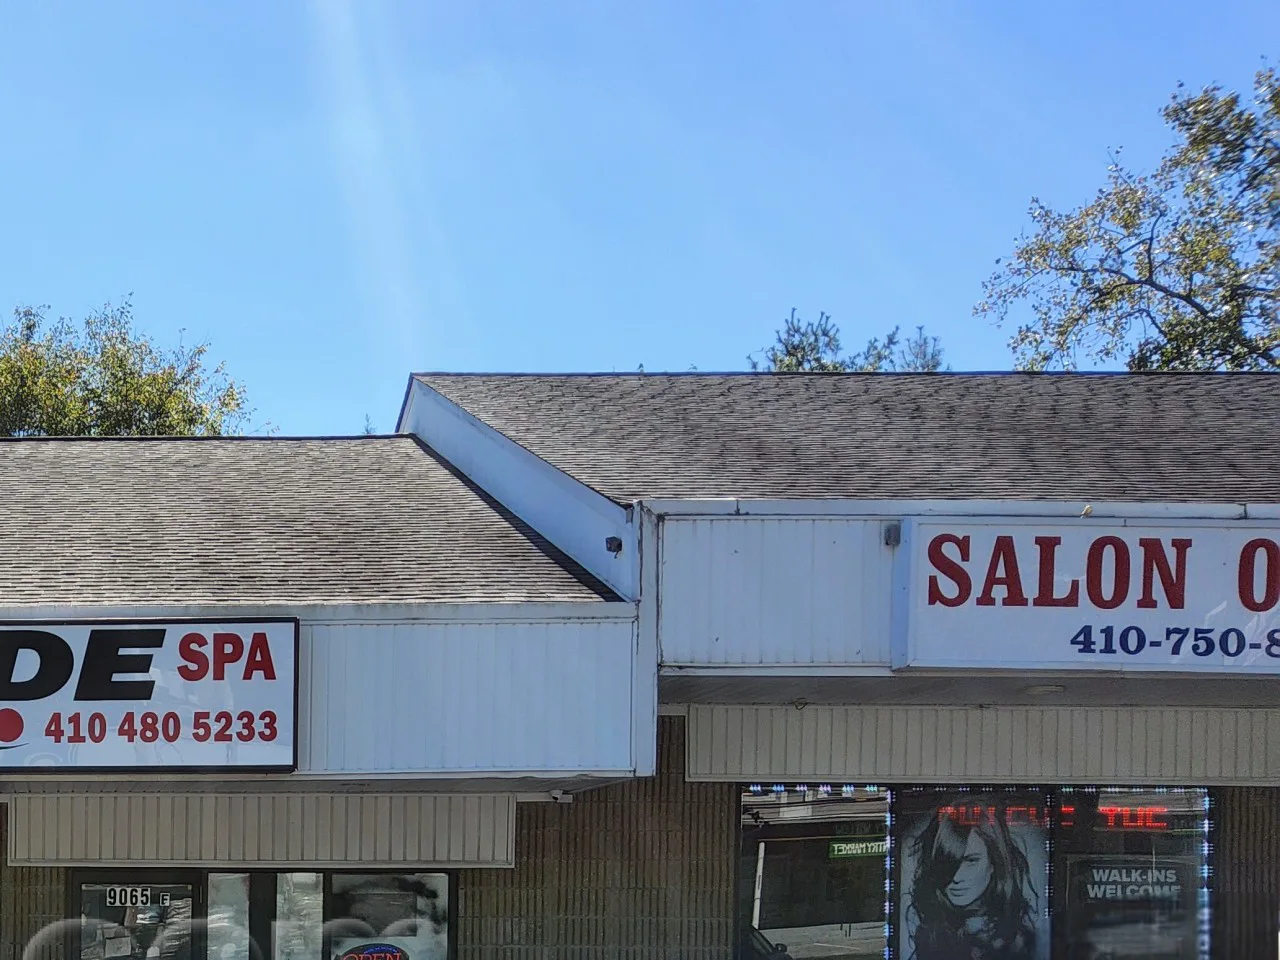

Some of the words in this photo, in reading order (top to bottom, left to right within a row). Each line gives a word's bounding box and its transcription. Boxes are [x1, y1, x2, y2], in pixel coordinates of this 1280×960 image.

[928, 533, 1193, 609] SALON
[177, 633, 276, 681] SPA
[45, 712, 107, 744] 410
[118, 711, 181, 743] 480
[192, 710, 278, 742] 5233
[1092, 868, 1177, 883] WALK-INS
[108, 888, 150, 906] 9065
